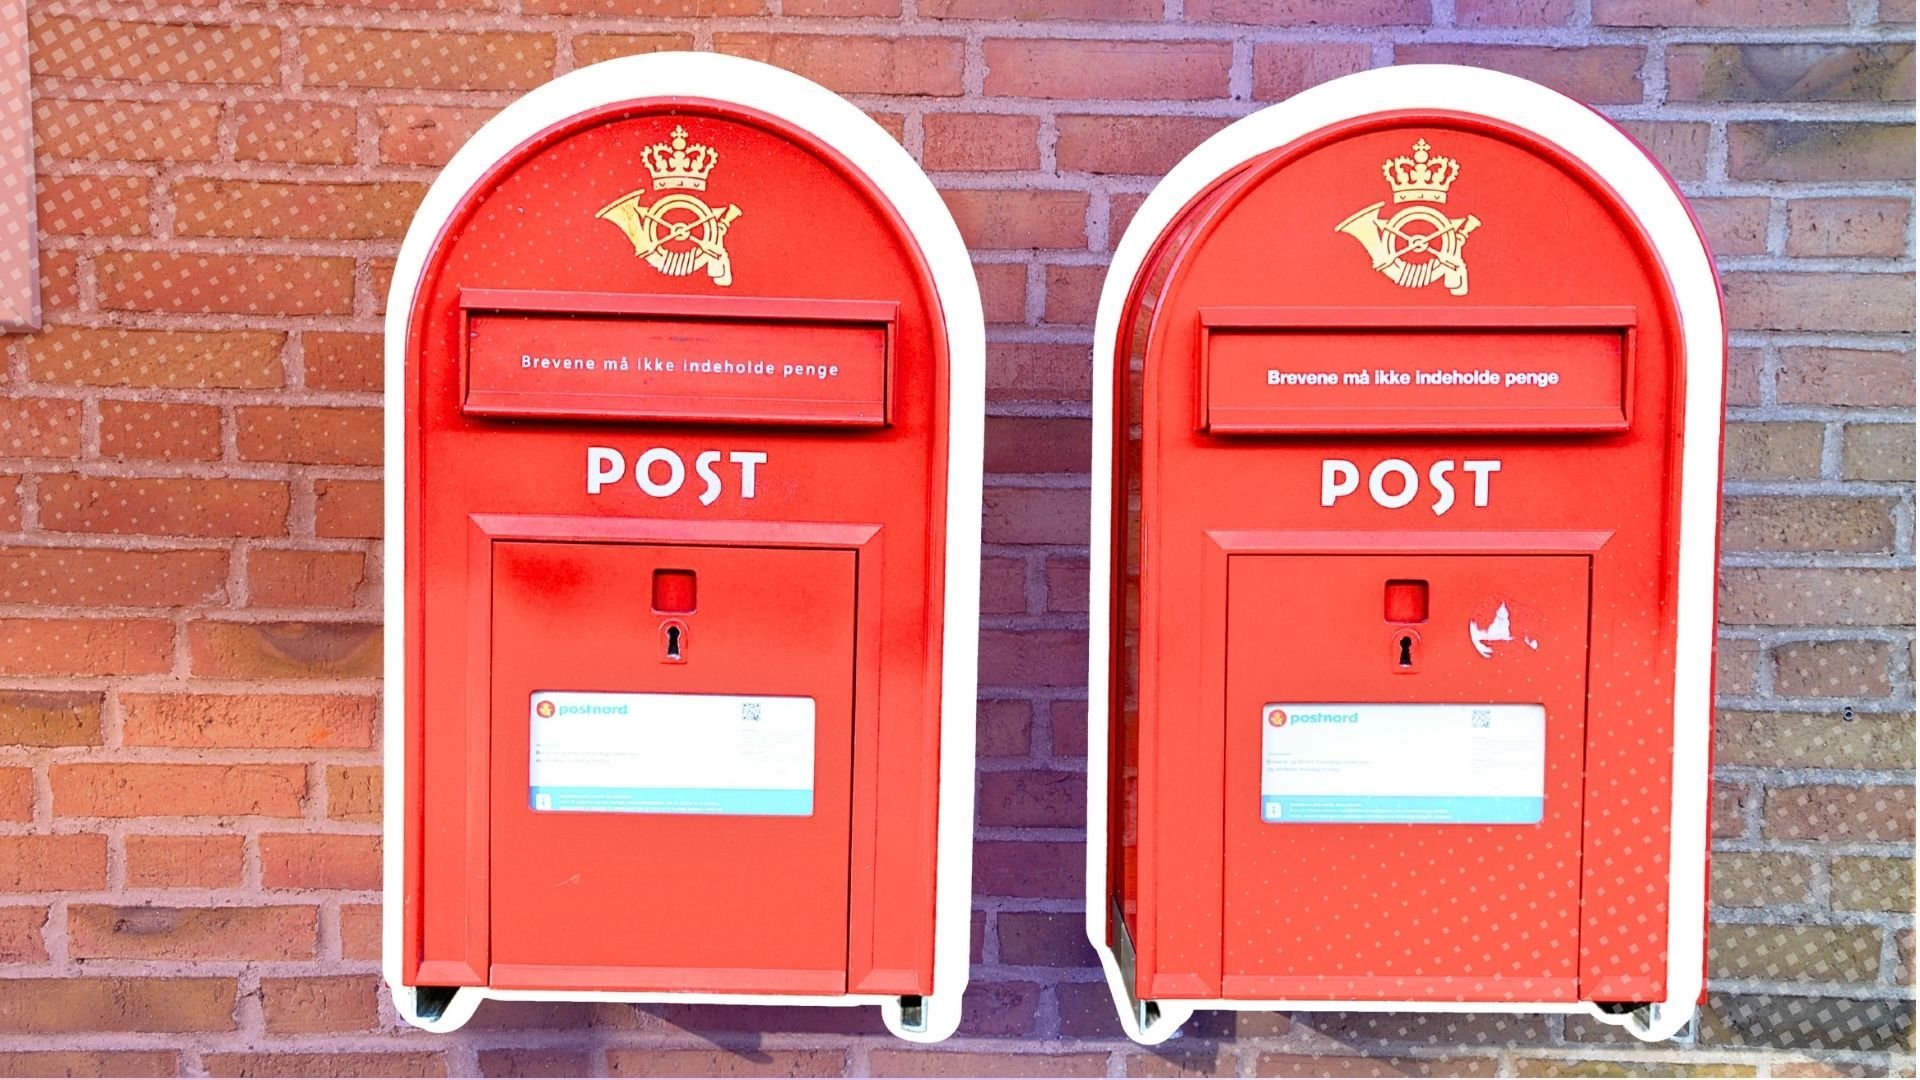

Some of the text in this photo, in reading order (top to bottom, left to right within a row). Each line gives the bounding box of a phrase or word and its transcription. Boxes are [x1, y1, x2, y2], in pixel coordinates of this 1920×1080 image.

[521, 354, 839, 380] Brevene må ikke indeholde penge
[1267, 368, 1559, 387] Brevene må ikke indeholde penge
[587, 447, 767, 506] POST
[1321, 458, 1501, 516] POST
[559, 703, 628, 716] postnord
[1289, 711, 1359, 725] postnord
